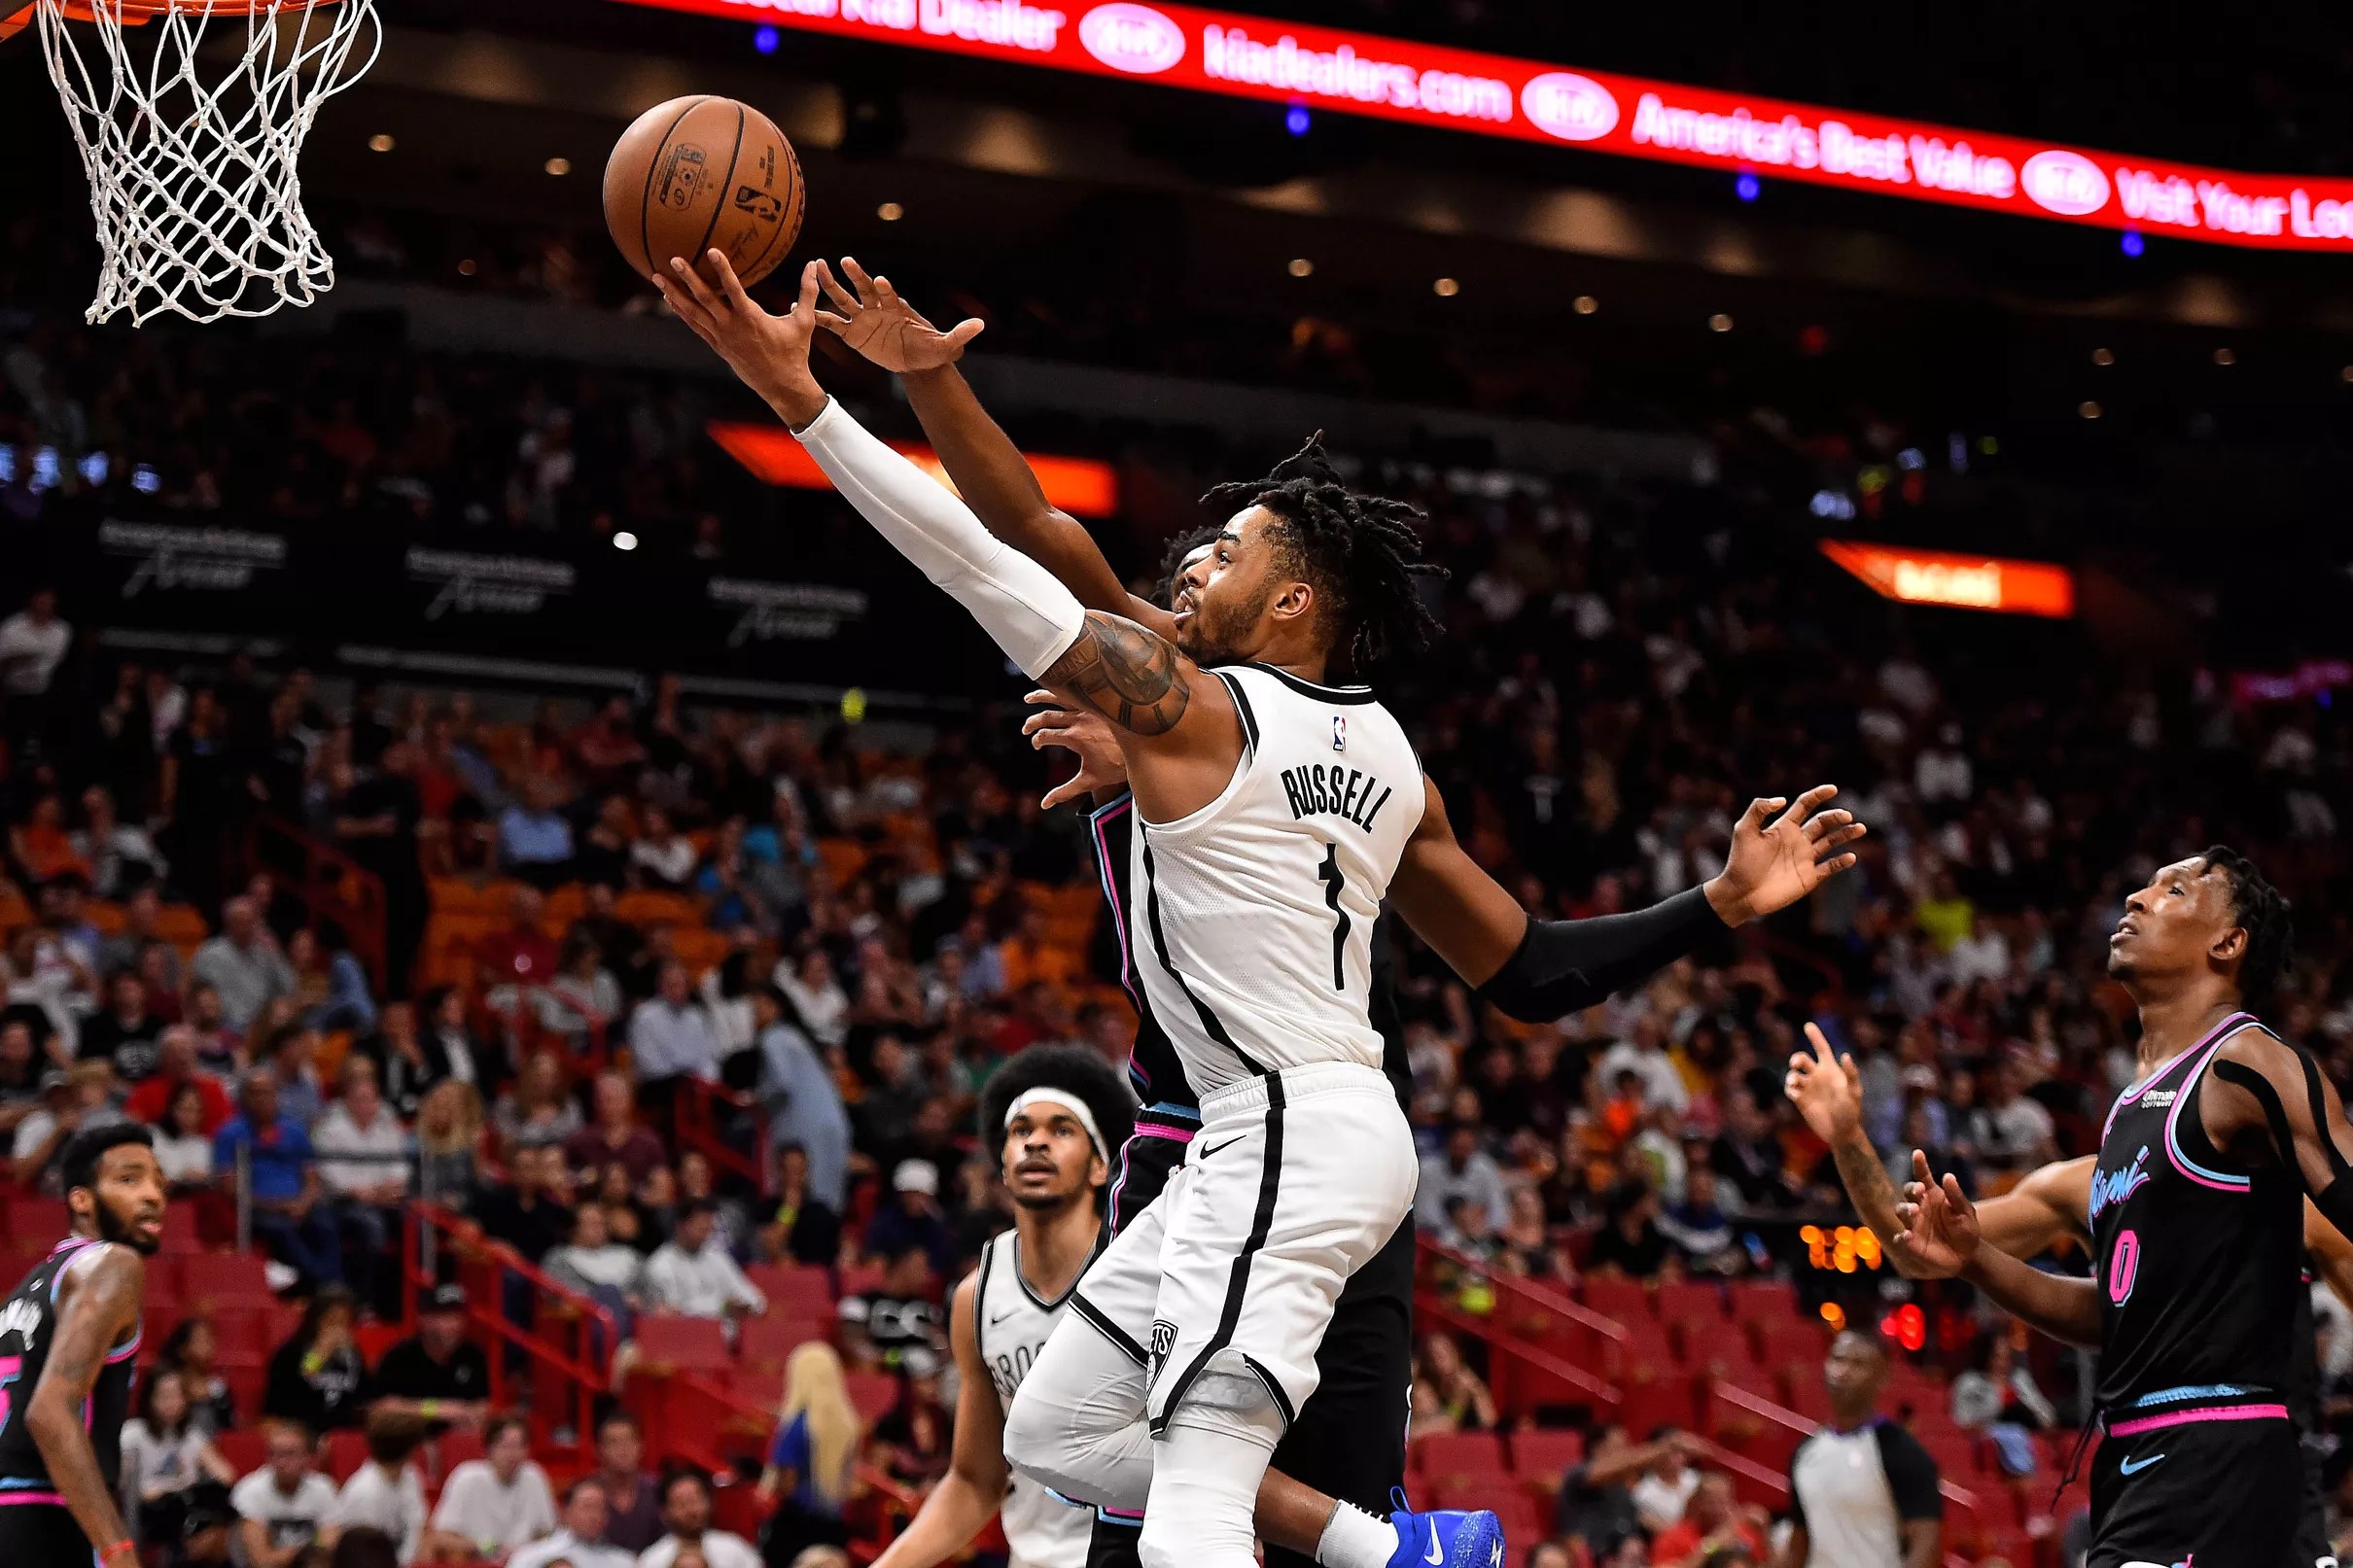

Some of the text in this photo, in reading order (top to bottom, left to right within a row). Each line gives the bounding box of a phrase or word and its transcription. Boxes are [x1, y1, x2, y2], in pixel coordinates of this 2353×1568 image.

[1281, 764, 1391, 834] RUSSELL
[1318, 843, 1352, 991] 1
[2109, 1229, 2140, 1307] 0
